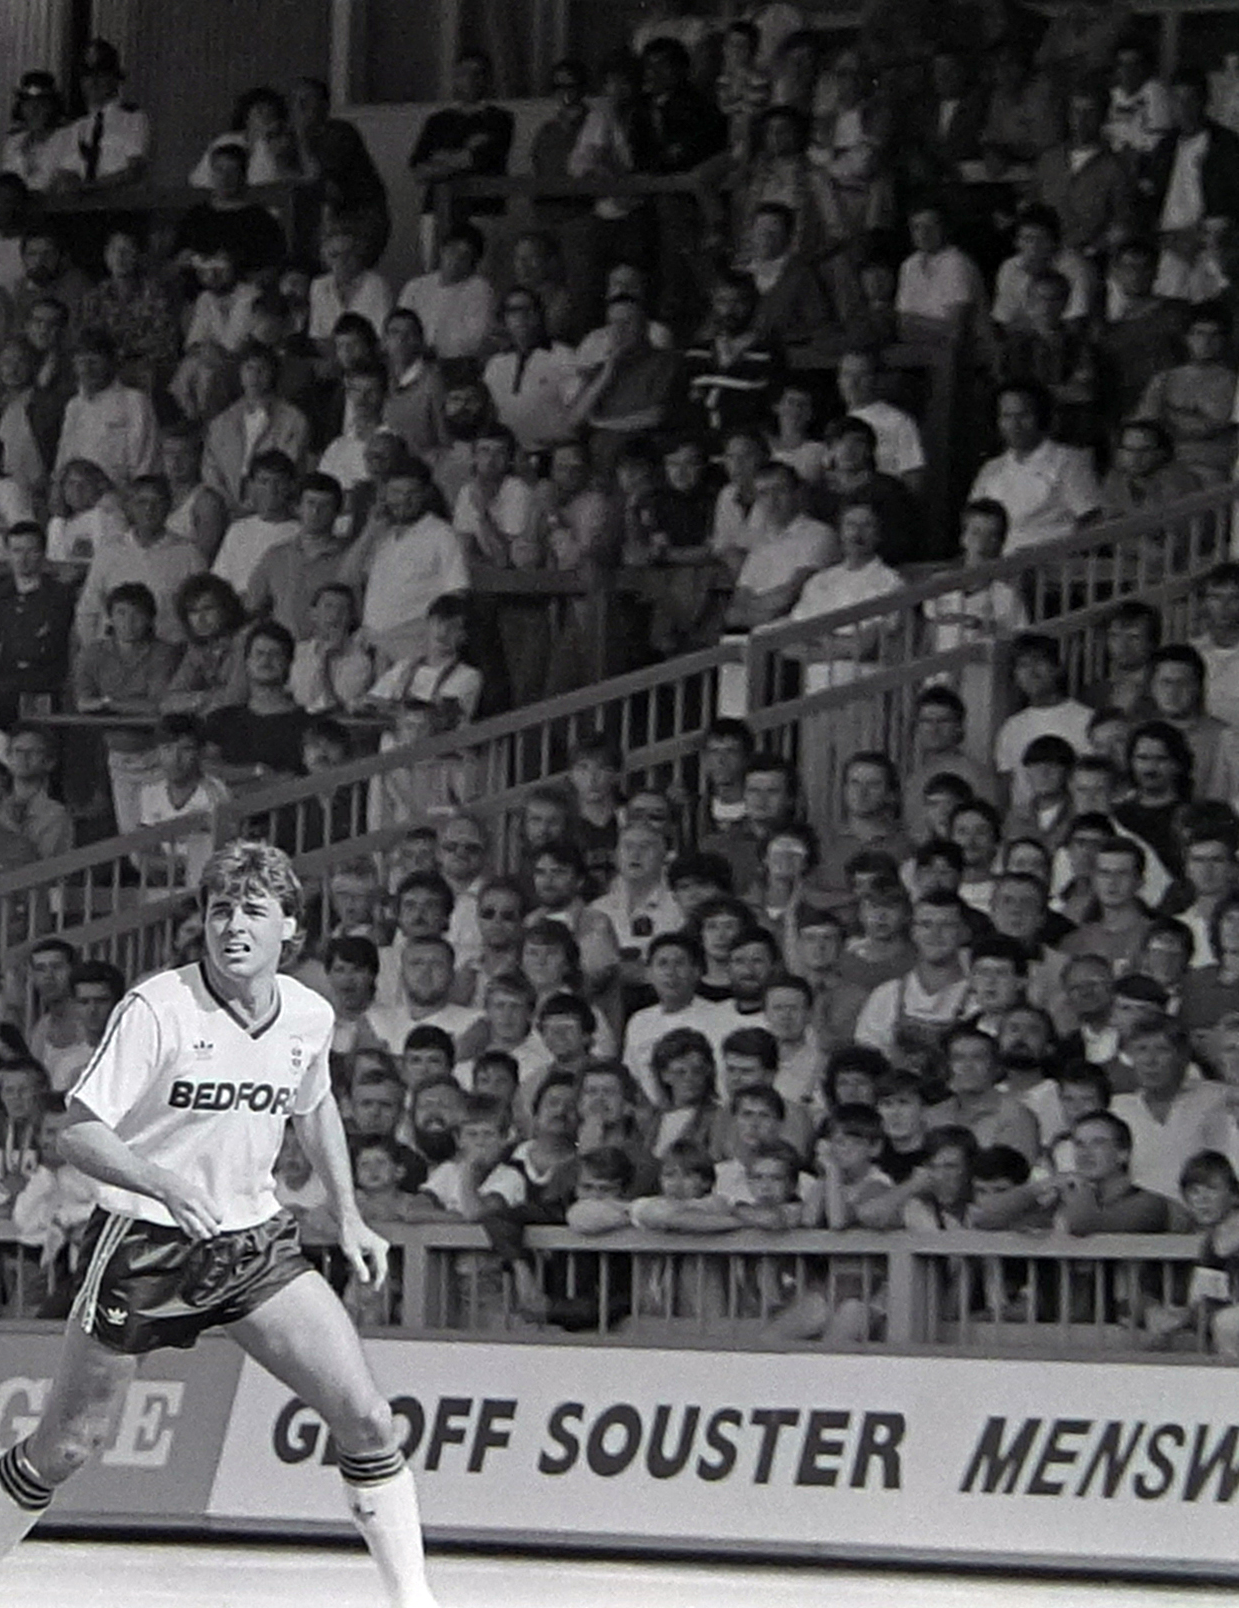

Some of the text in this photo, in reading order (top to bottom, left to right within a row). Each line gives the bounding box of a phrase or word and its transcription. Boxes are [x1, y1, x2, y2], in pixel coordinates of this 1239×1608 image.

[168, 1081, 297, 1115] BEDFOR
[273, 1396, 1239, 1502] GOFF SOUSTER MENSW
